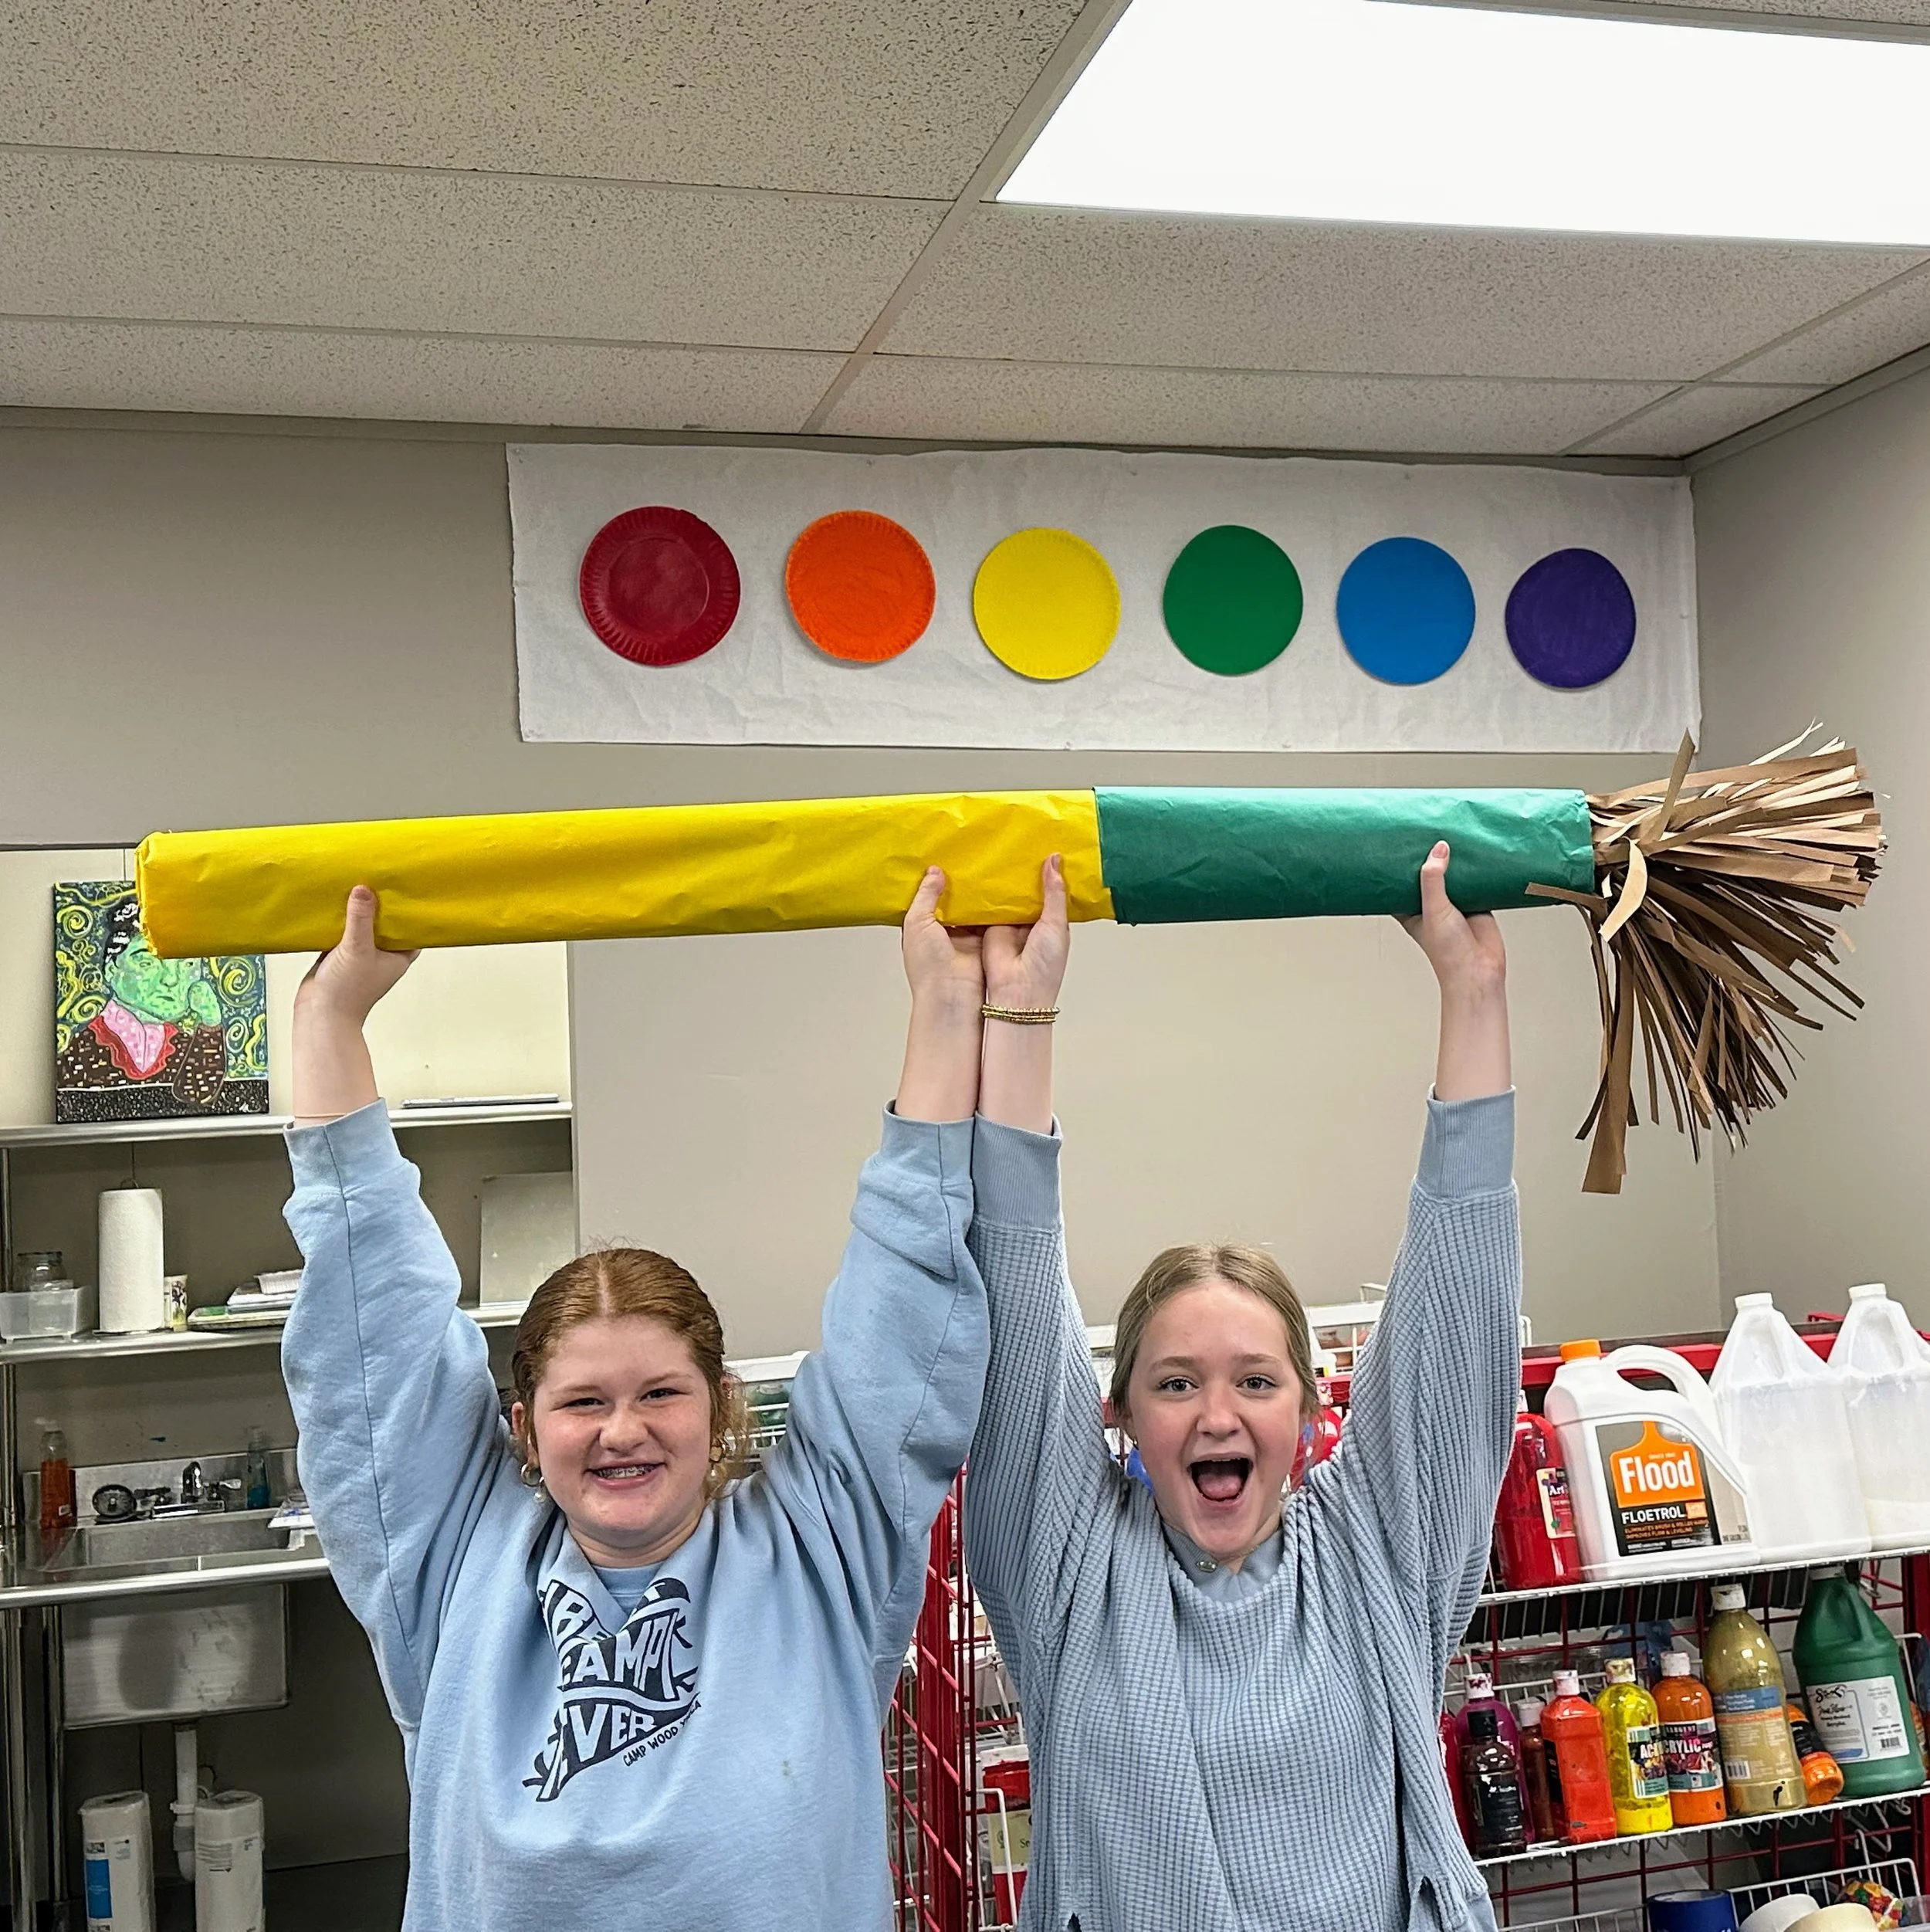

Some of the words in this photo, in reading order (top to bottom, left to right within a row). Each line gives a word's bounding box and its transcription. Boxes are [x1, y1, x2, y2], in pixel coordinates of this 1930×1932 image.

[1619, 1451, 1695, 1494] Flood
[1621, 1506, 1686, 1525] FLOETROL
[623, 1745, 646, 1766] CAMP
[647, 1726, 679, 1750] WOOD
